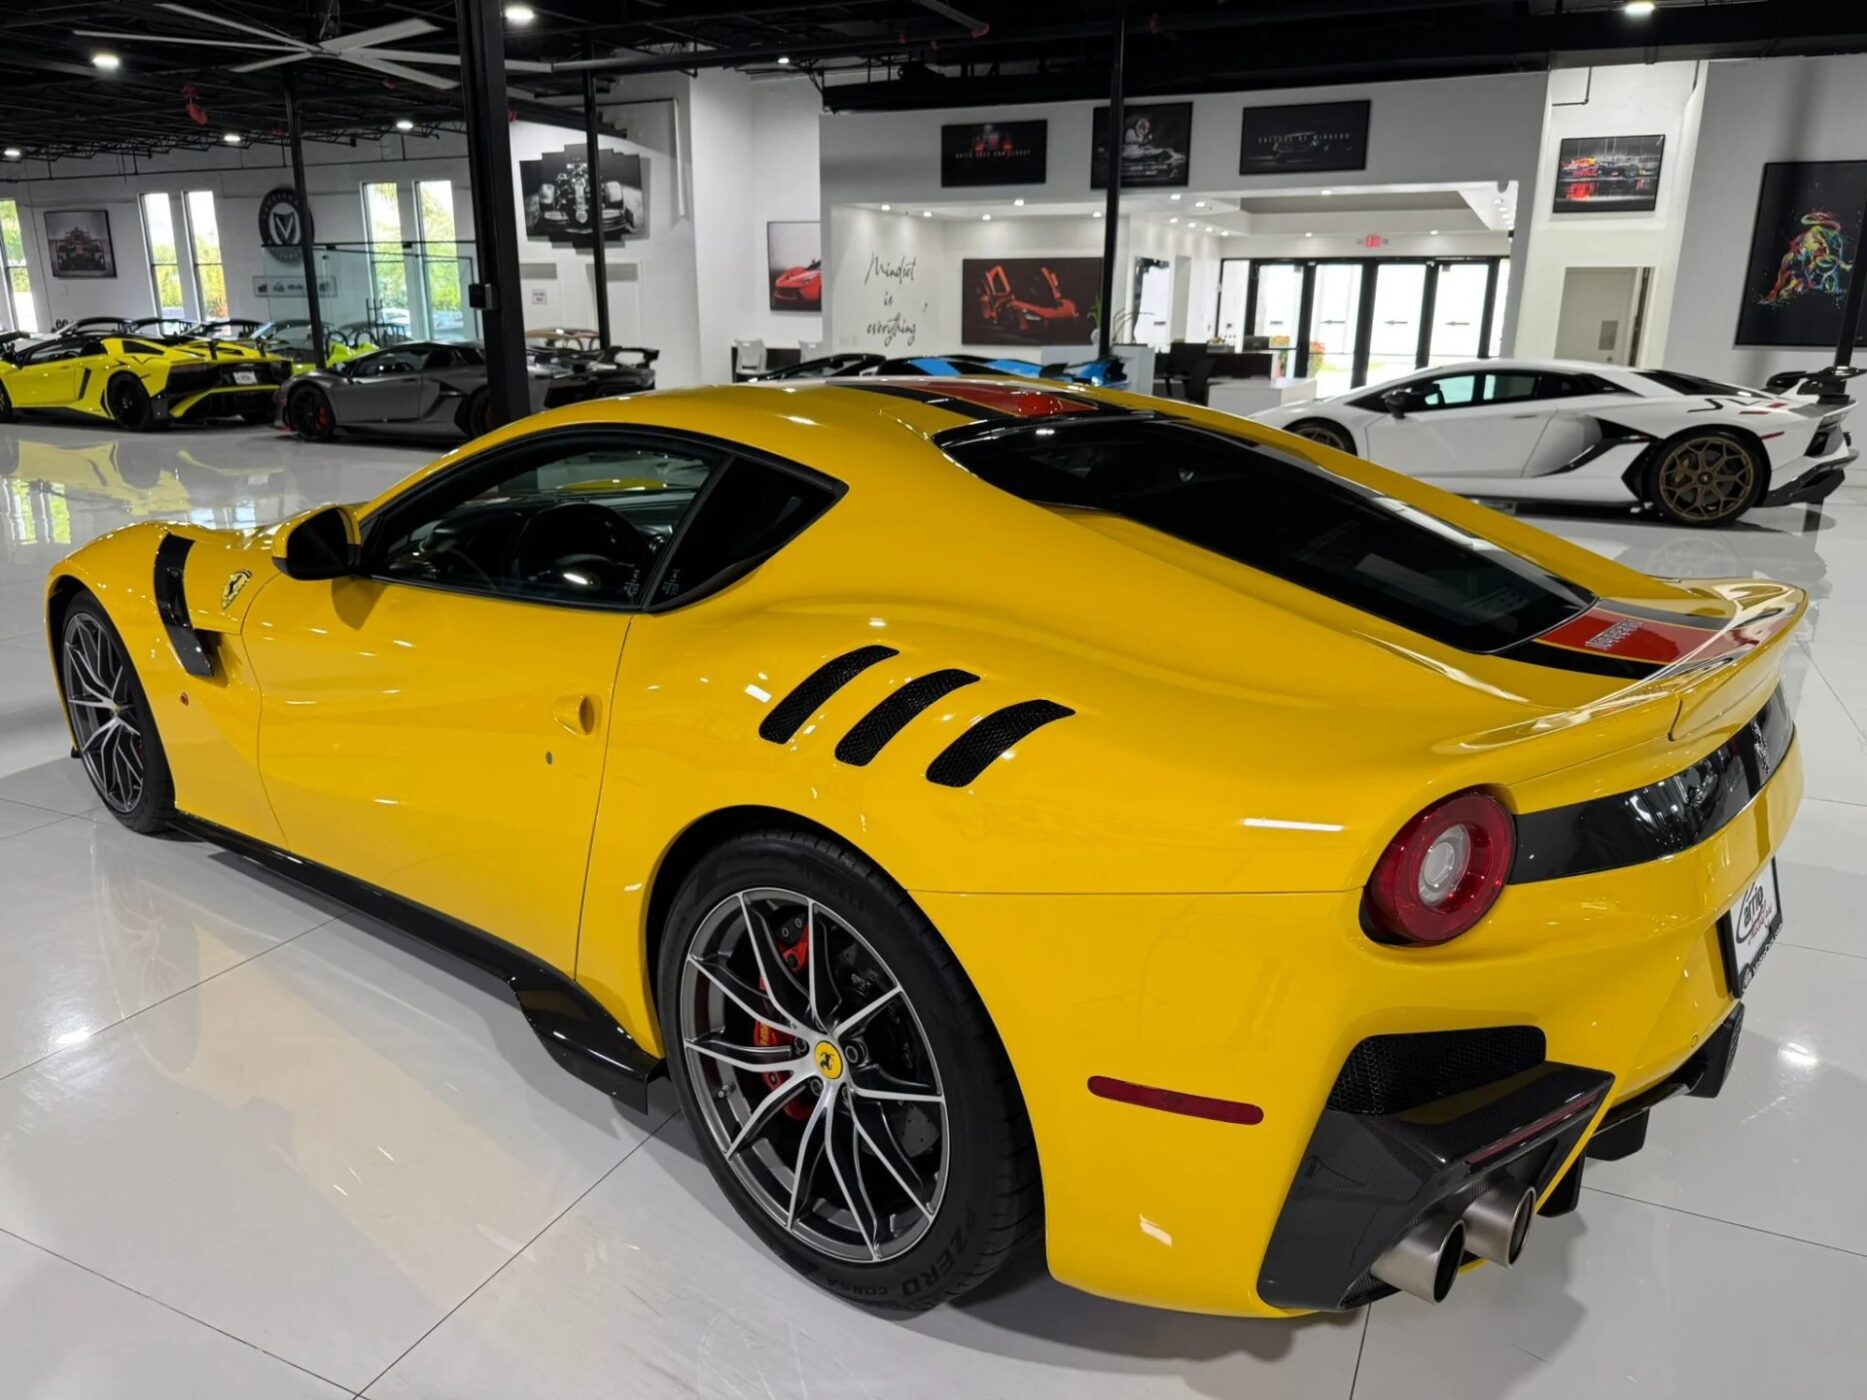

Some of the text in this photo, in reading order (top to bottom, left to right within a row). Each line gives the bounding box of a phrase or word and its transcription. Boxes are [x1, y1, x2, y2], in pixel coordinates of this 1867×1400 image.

[864, 251, 918, 285] Mindset
[883, 294, 894, 307] is
[866, 313, 918, 347] everything
[900, 1224, 970, 1298] ZERO
